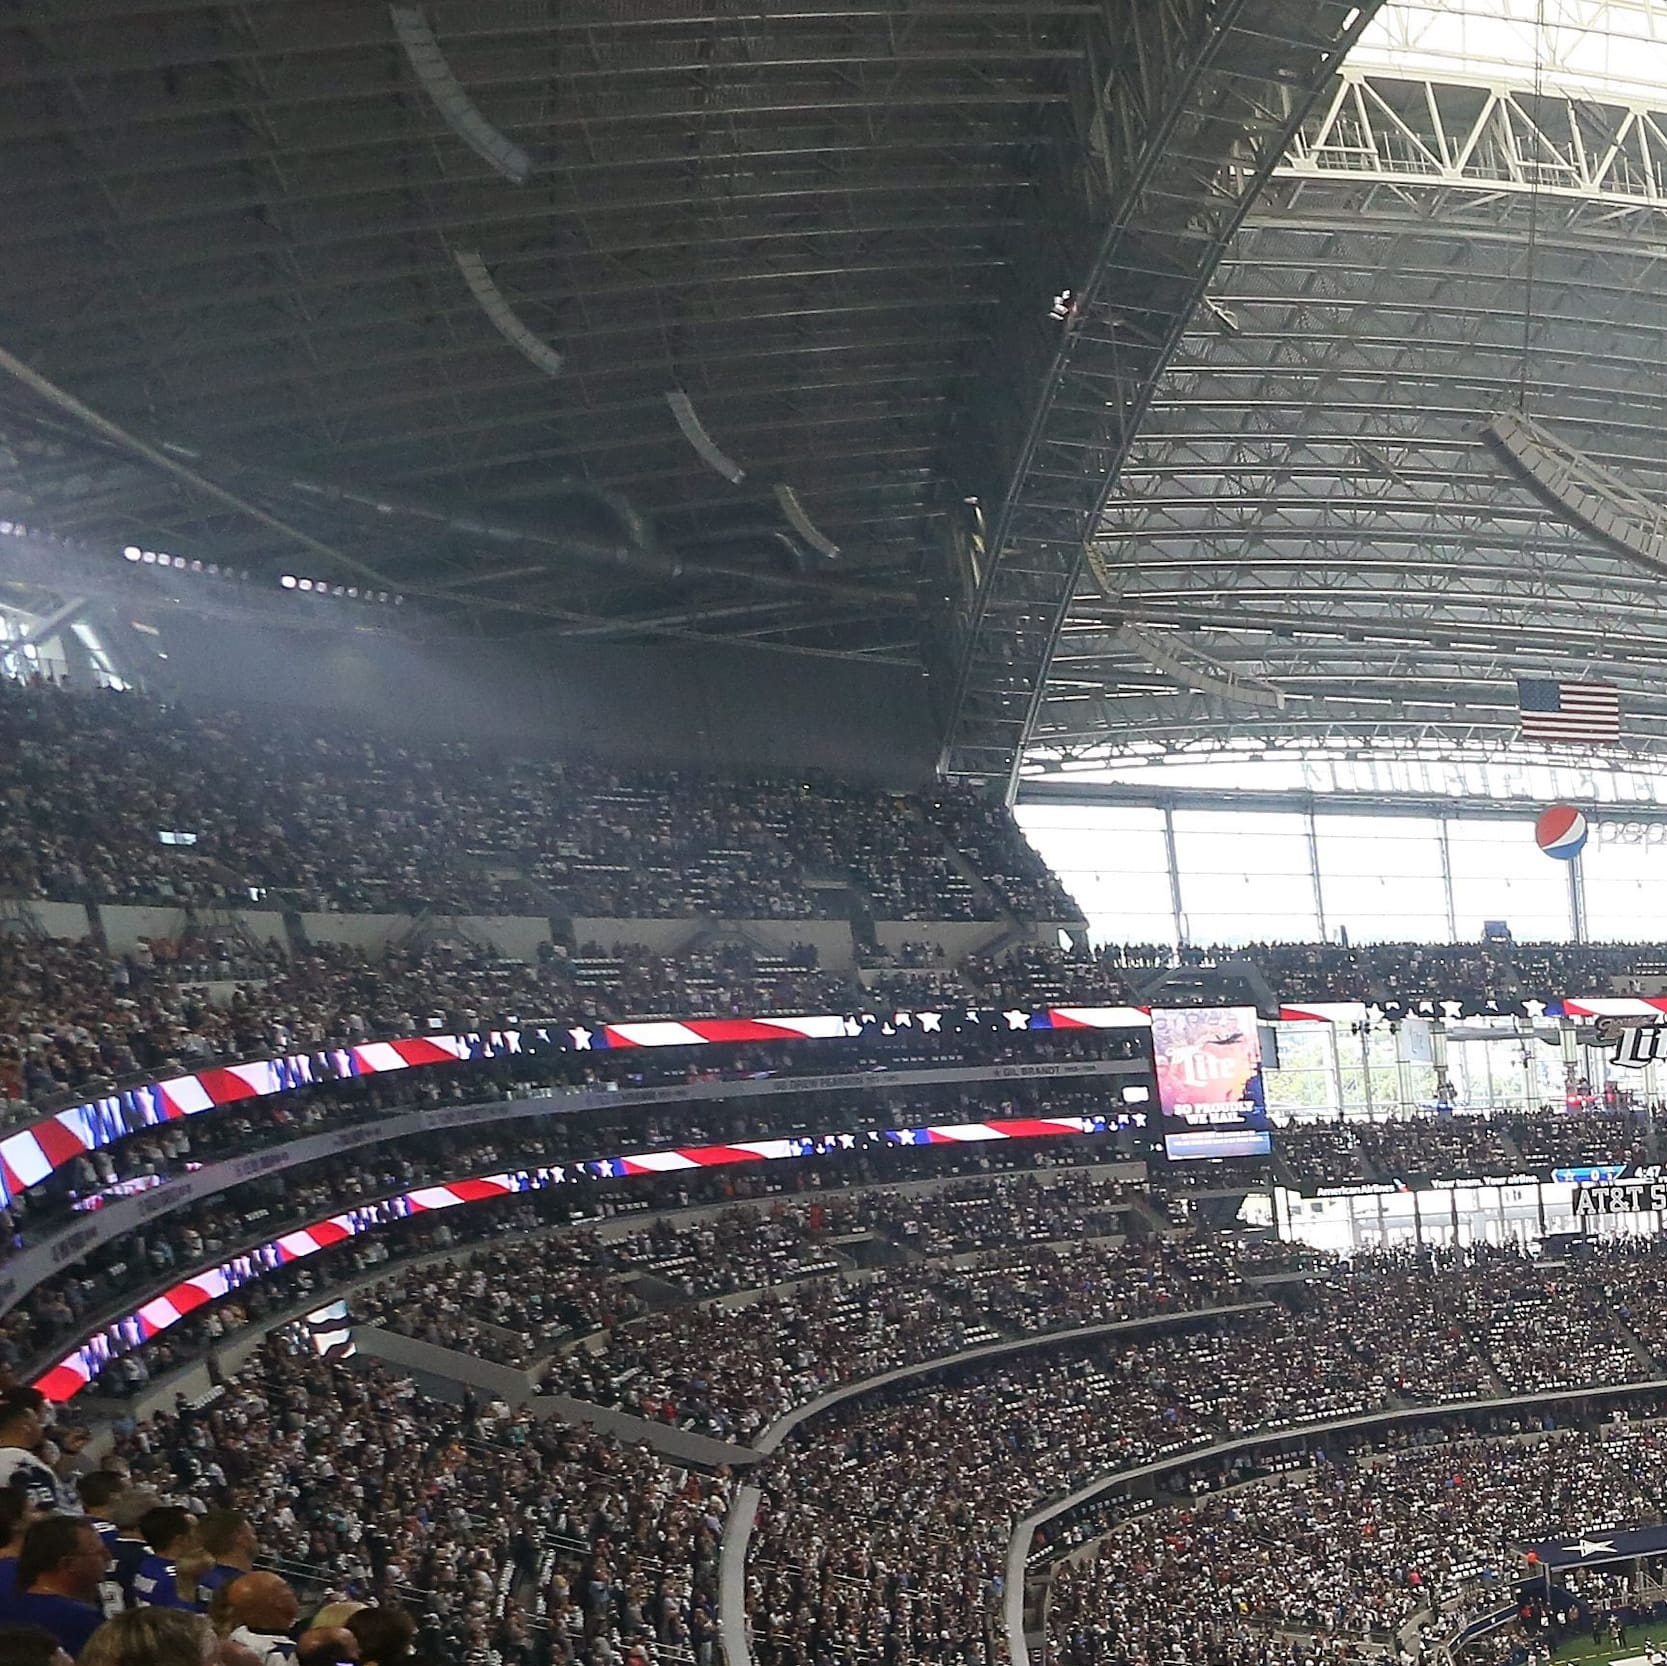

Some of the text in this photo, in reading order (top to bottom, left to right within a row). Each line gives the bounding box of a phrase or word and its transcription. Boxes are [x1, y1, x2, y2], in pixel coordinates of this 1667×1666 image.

[1634, 1165, 1662, 1178] 4:47
[1431, 1179, 1454, 1189] Your
[1484, 1175, 1508, 1186] Your
[1576, 1184, 1645, 1216] AT&T
